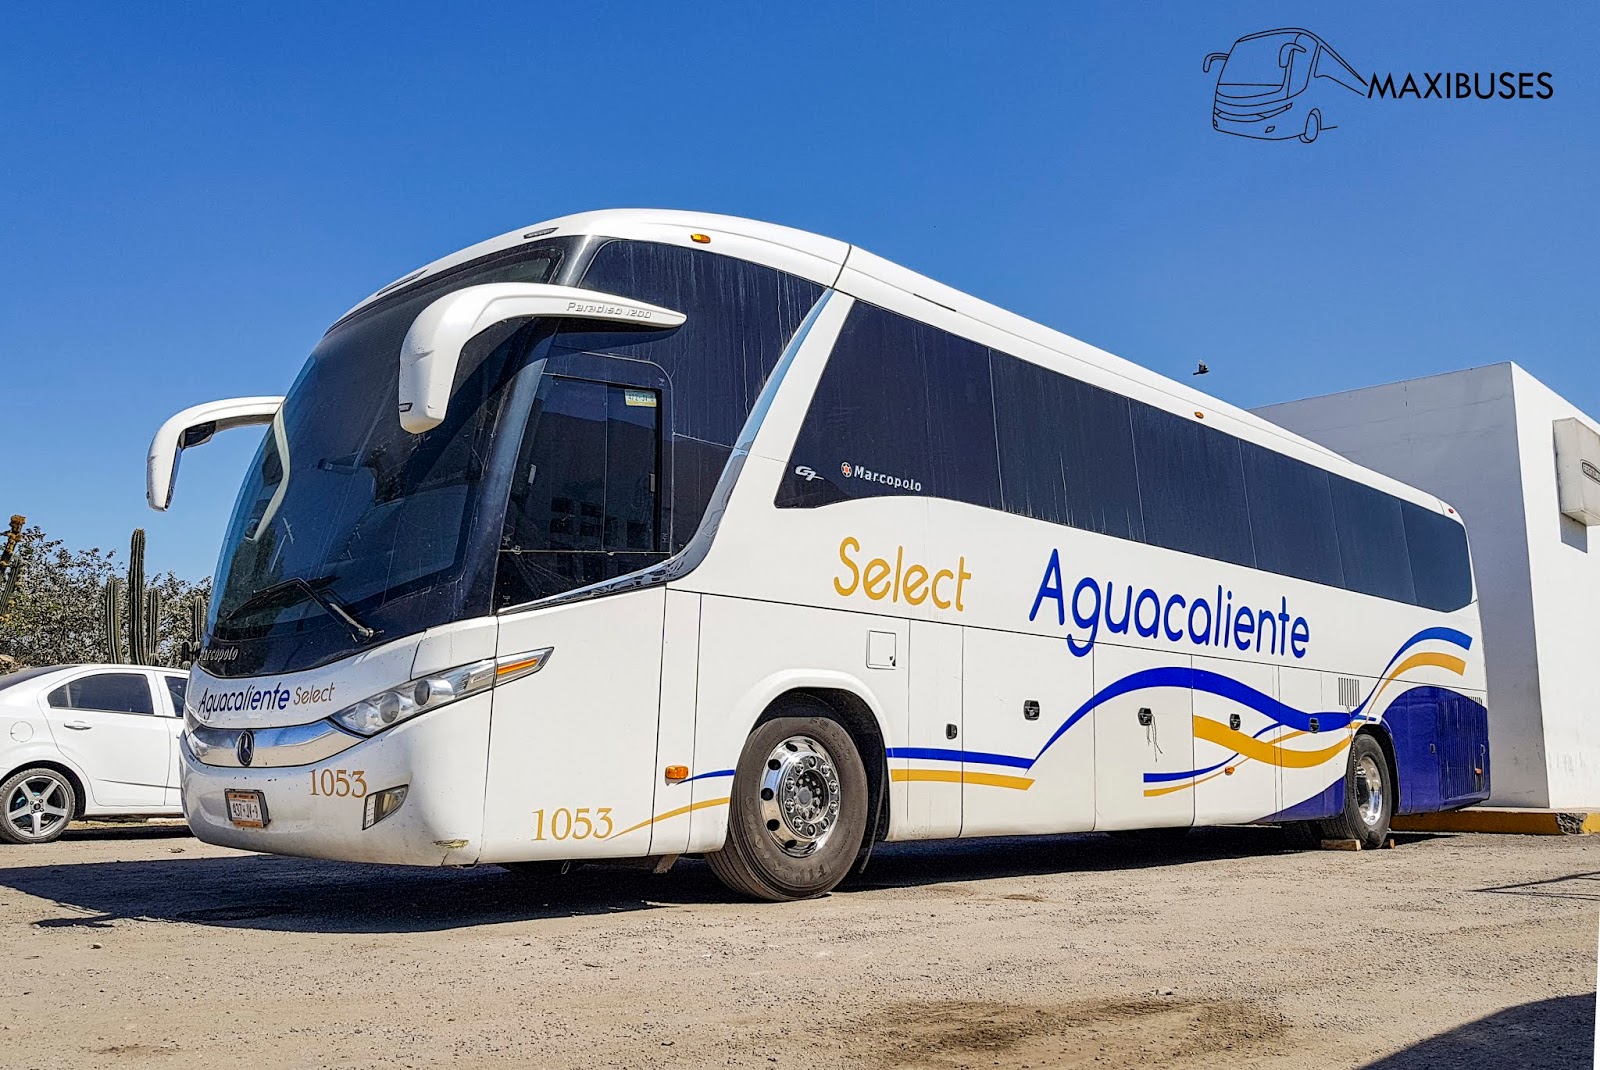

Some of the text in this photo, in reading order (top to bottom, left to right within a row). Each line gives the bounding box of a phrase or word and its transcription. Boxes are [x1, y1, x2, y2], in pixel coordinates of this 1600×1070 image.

[566, 302, 652, 319] Paradiso 1200
[854, 465, 922, 492] Marcopolo
[833, 536, 972, 612] Select
[1029, 548, 1310, 658] Aguacaliente
[197, 682, 335, 720] Aguacaliente Select
[309, 768, 367, 798] 1053
[530, 807, 614, 841] 1053
